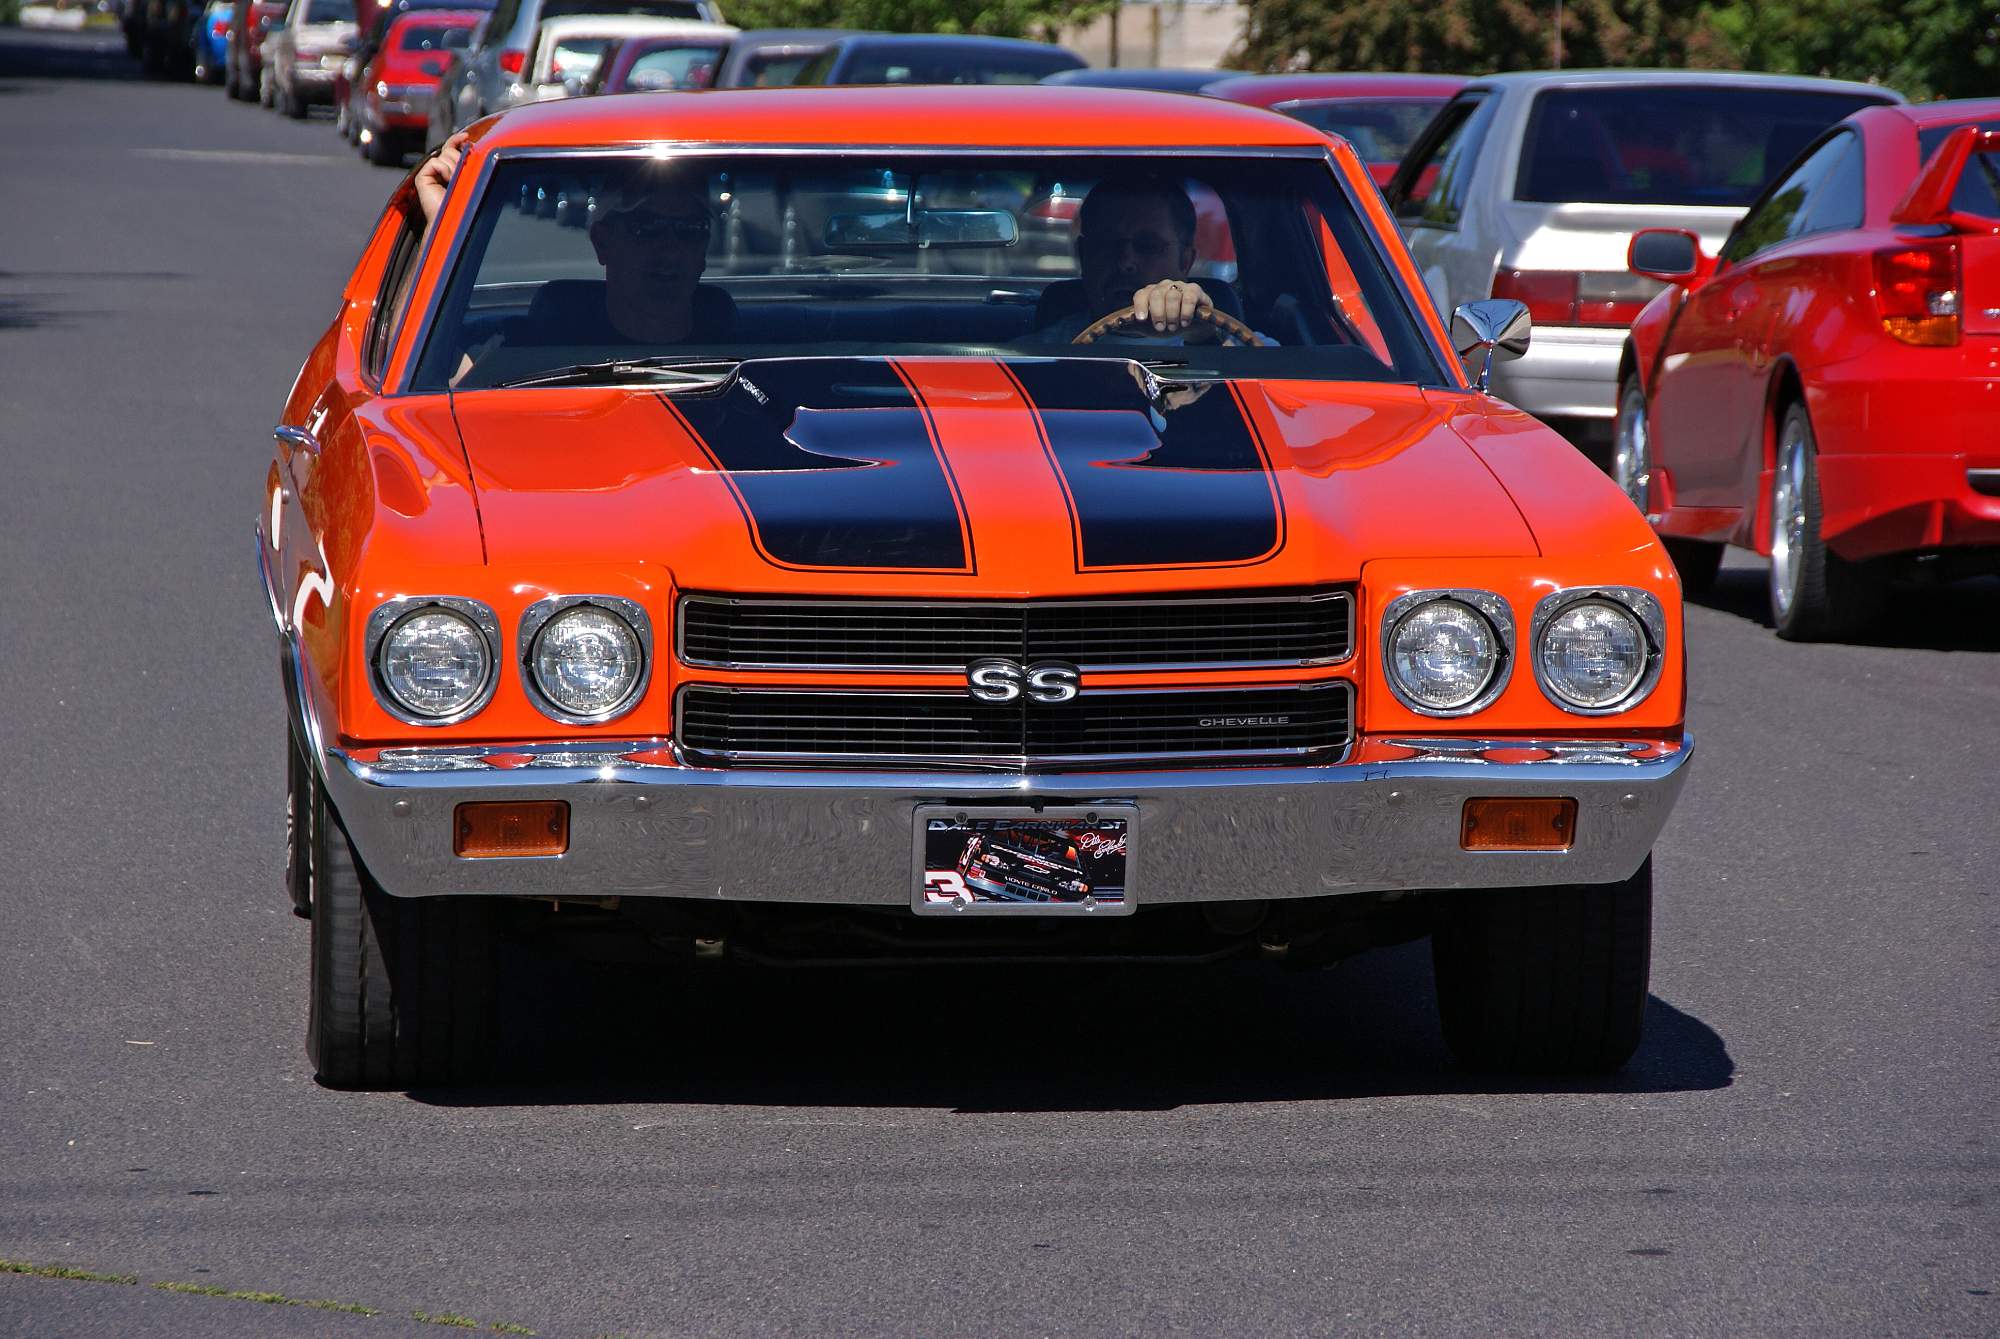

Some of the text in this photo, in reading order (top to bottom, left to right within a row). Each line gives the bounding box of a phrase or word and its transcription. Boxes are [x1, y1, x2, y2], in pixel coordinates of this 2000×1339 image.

[967, 660, 1081, 703] SS
[1199, 716, 1289, 727] CHEVELLE
[925, 870, 976, 903] 3
